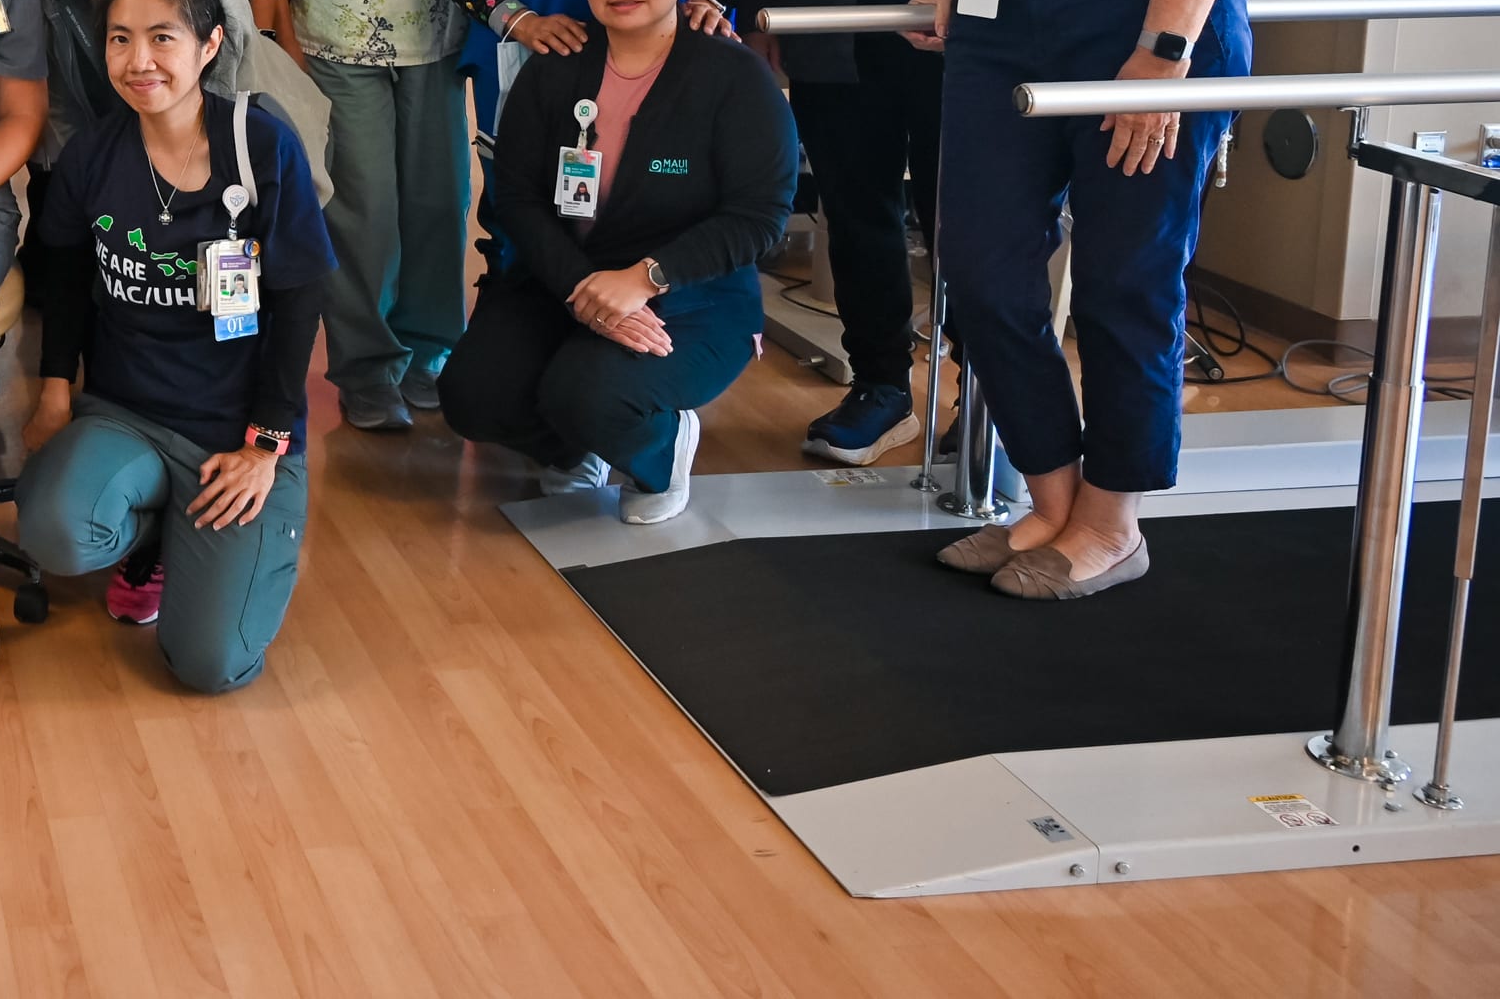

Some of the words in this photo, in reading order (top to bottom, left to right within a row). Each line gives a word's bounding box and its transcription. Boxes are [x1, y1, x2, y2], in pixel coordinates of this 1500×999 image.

[663, 158, 688, 168] MAUI
[110, 253, 147, 281] ARE
[227, 316, 244, 333] OT
